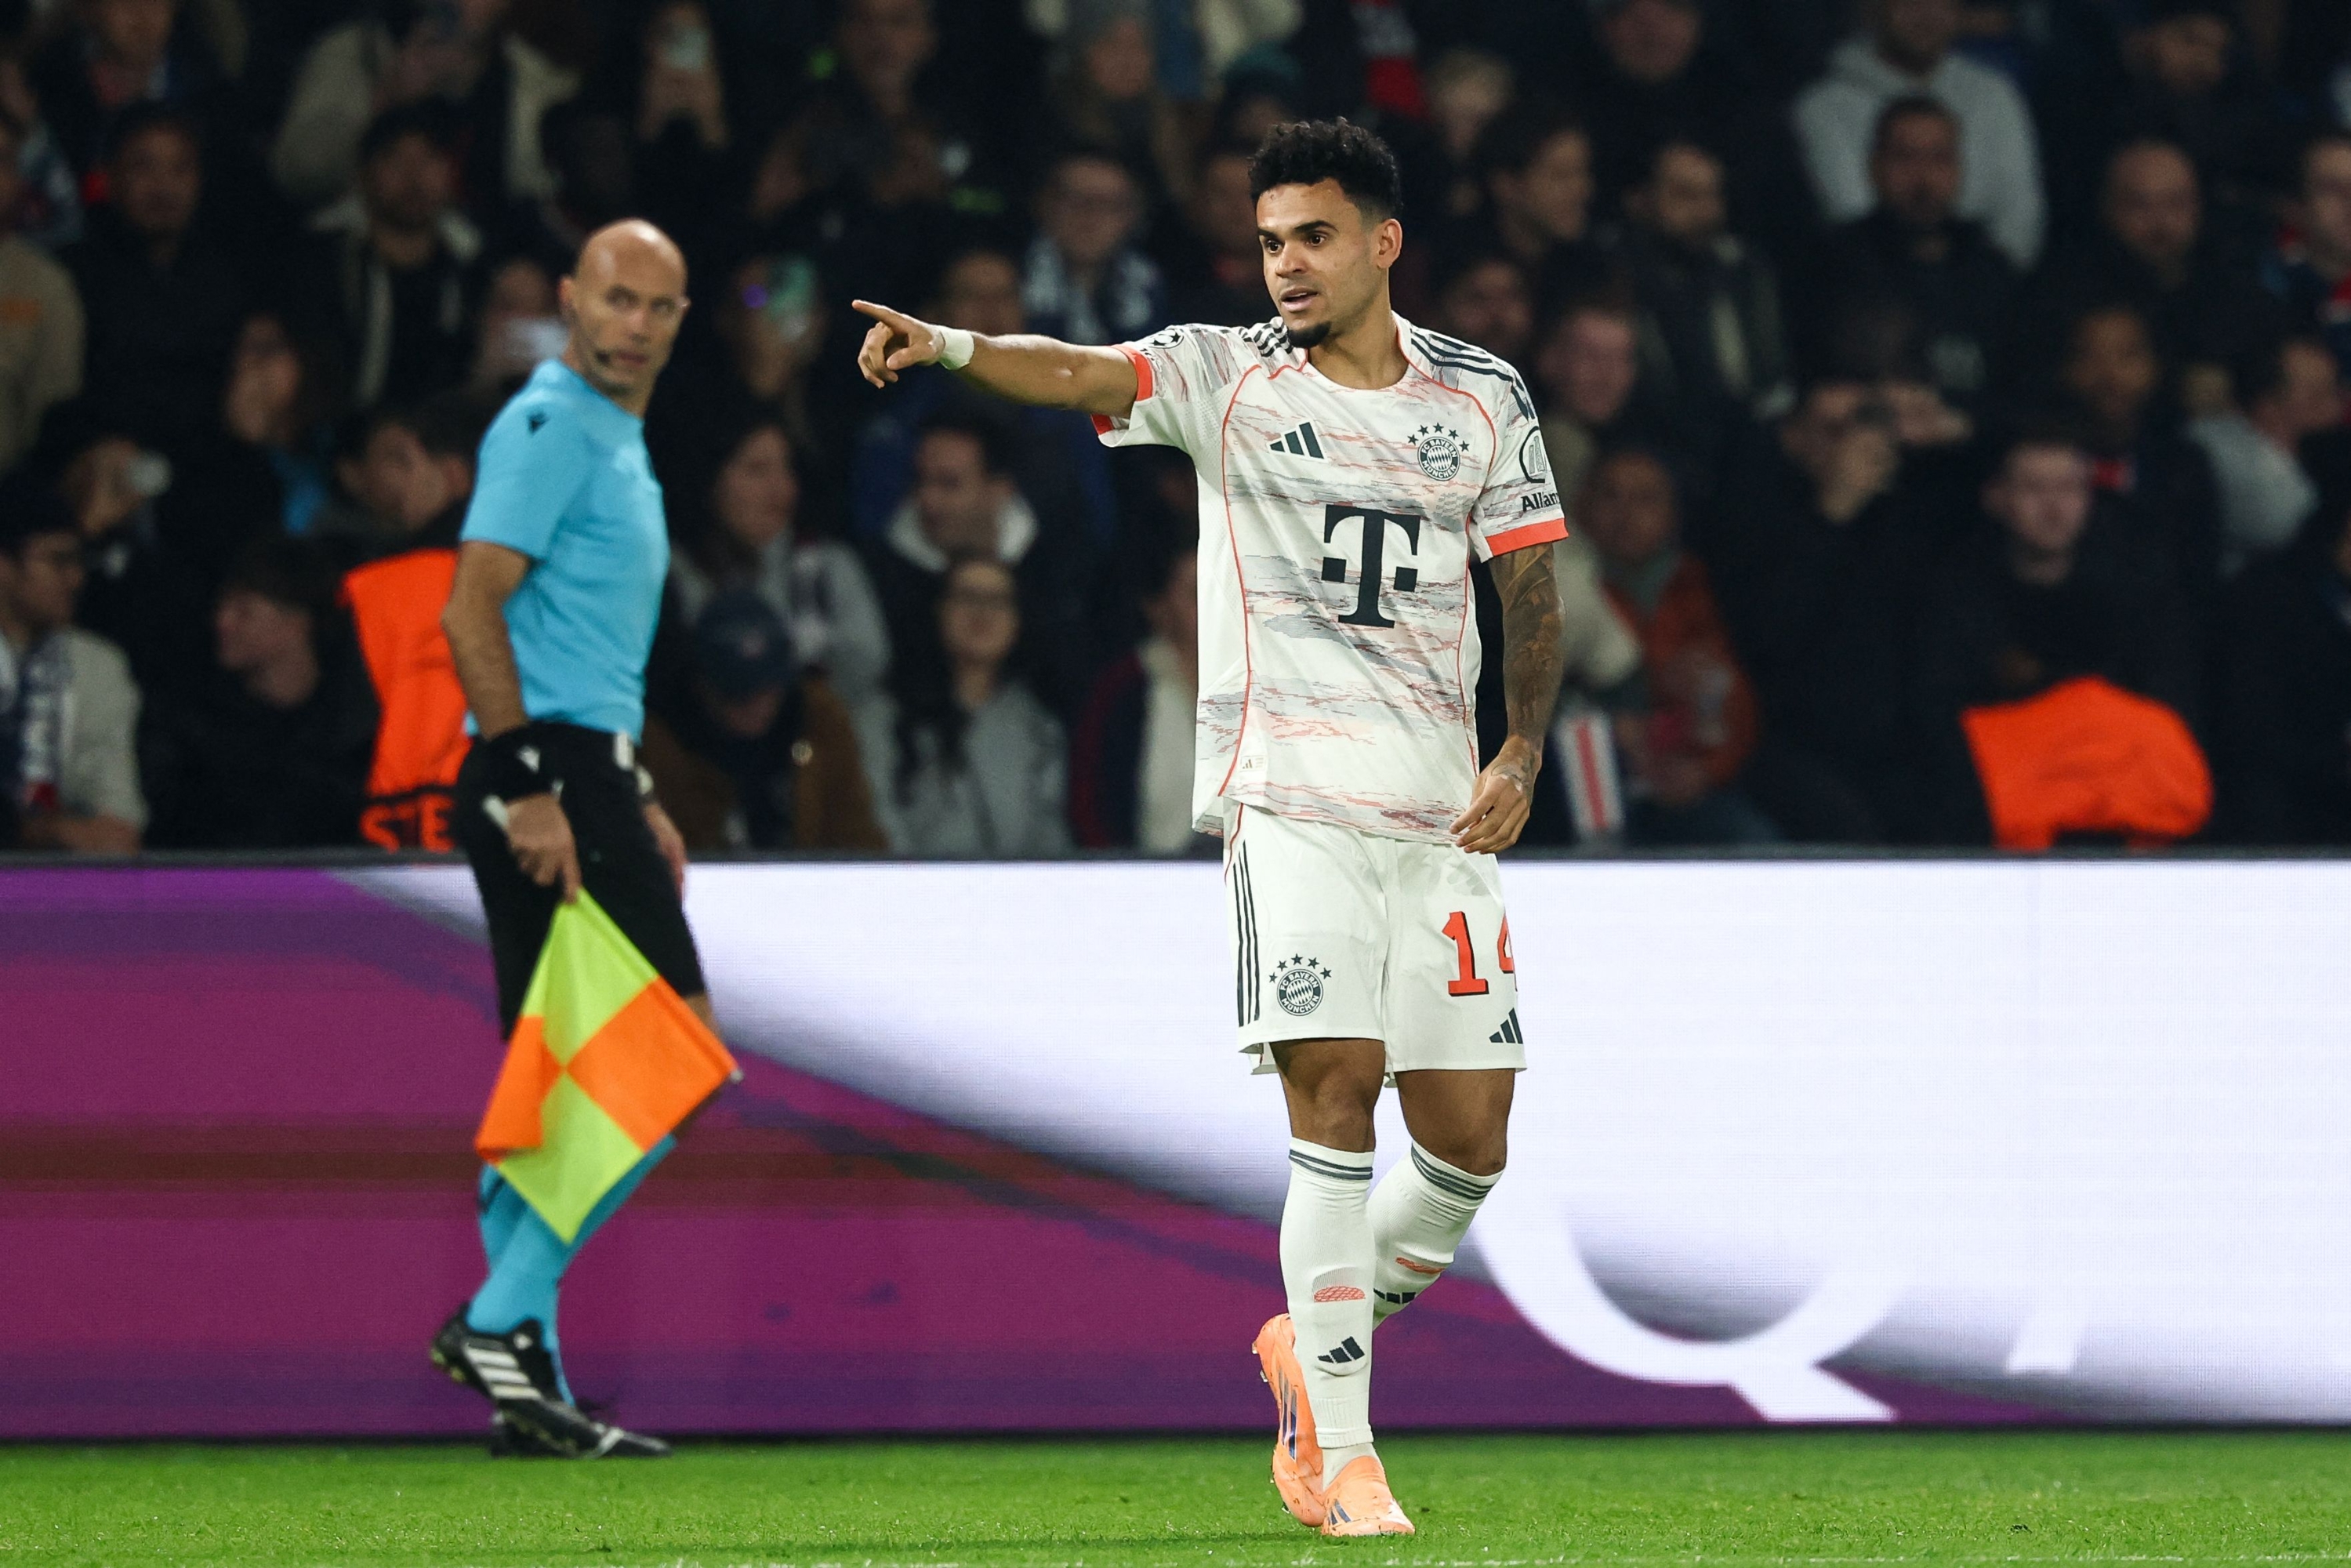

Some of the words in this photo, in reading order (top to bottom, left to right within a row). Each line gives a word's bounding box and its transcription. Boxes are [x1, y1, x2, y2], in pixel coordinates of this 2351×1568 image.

[1420, 444, 1431, 454] FC
[1429, 439, 1457, 458] BAYERN
[1322, 504, 1420, 628] T
[1281, 979, 1289, 990] FC
[1289, 972, 1319, 988] BAYERN
